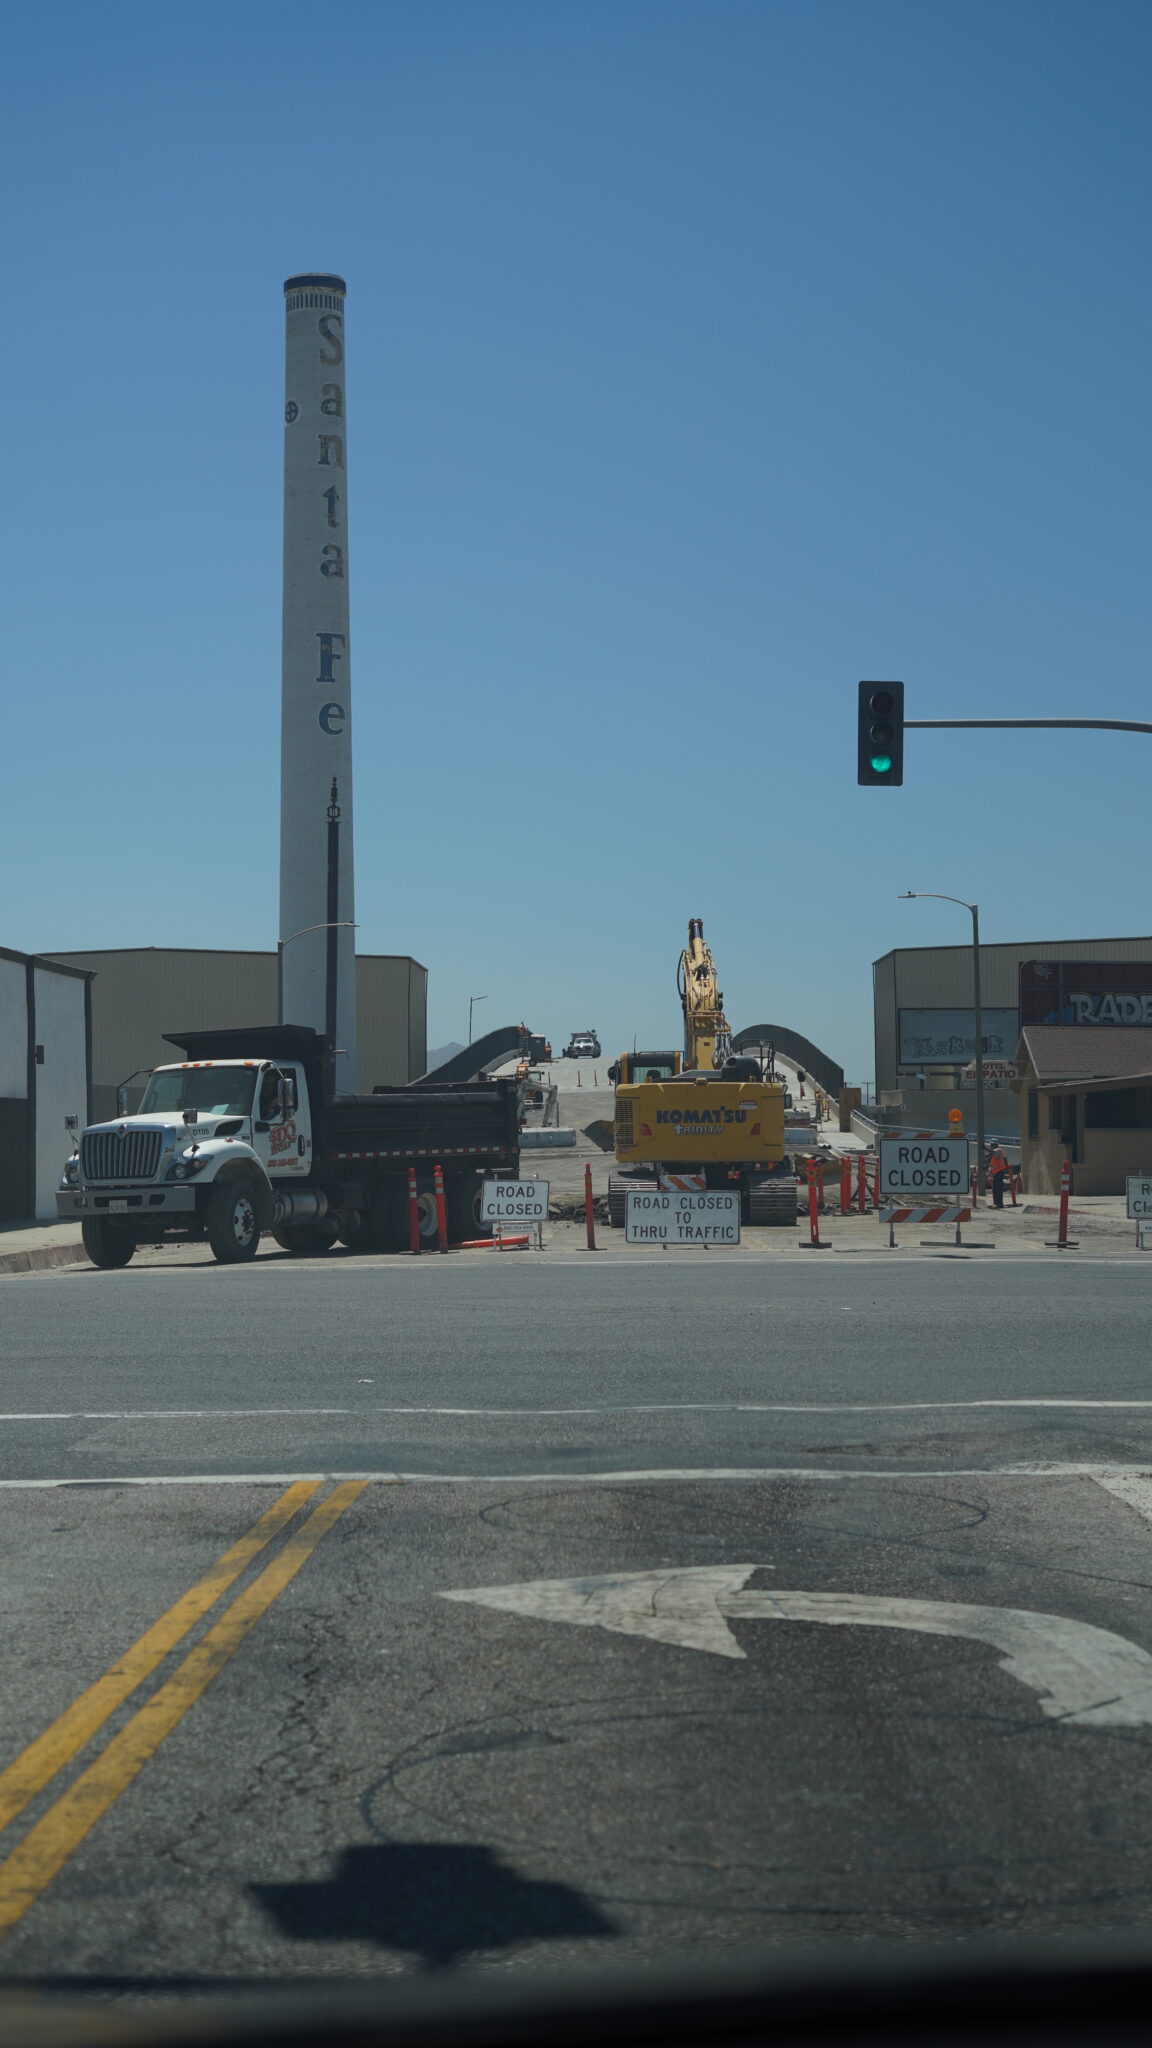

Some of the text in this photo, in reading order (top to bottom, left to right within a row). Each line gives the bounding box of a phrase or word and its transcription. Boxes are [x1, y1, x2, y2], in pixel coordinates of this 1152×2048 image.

[314, 314, 346, 735] Santa Fe
[983, 1062, 1006, 1070] OTEL
[983, 1070, 1016, 1079] PATIO
[656, 1105, 747, 1124] KOMATSU
[898, 1146, 950, 1163] ROAD
[888, 1169, 961, 1187] CLOSED
[496, 1187, 535, 1198] ROAD
[487, 1203, 542, 1215] CLOSED
[633, 1198, 733, 1209] ROAD CLOSED
[675, 1212, 692, 1223] TO
[632, 1226, 734, 1238] THRU TRAFFIC
